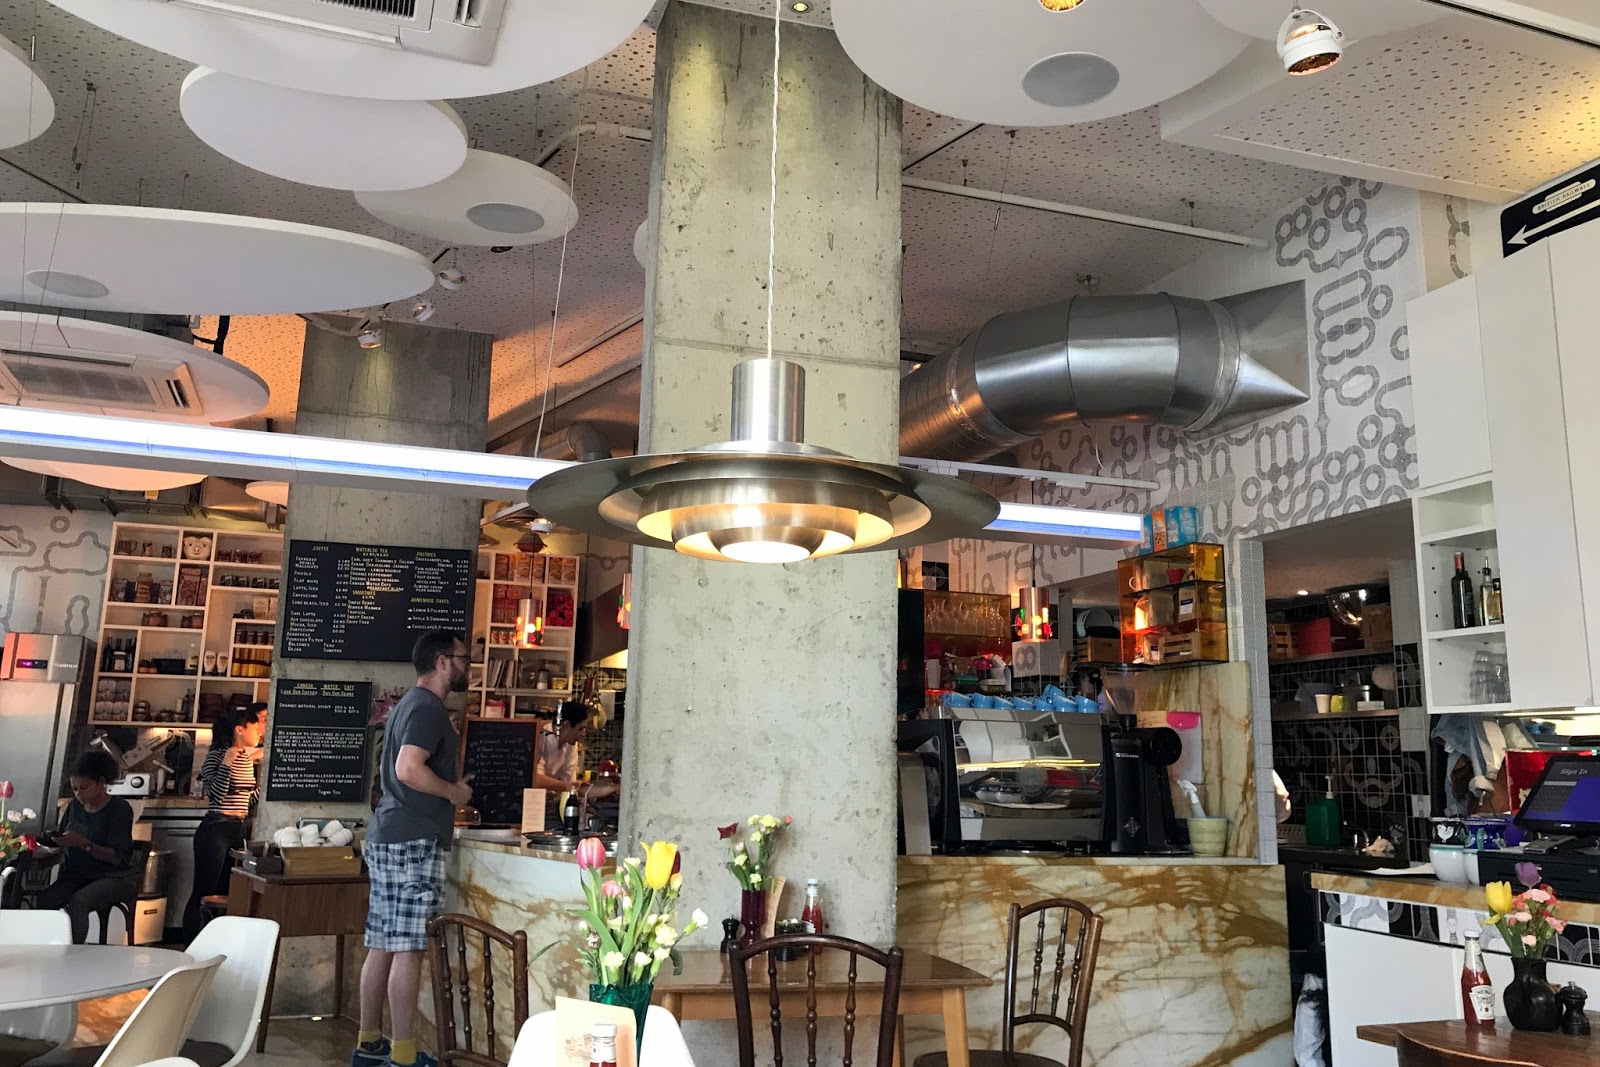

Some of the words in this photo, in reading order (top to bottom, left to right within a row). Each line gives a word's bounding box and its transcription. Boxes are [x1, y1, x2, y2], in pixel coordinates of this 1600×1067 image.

[1537, 197, 1560, 211] BRITISH
[1562, 183, 1590, 199] RAILWAYS
[1560, 768, 1578, 776] Sign
